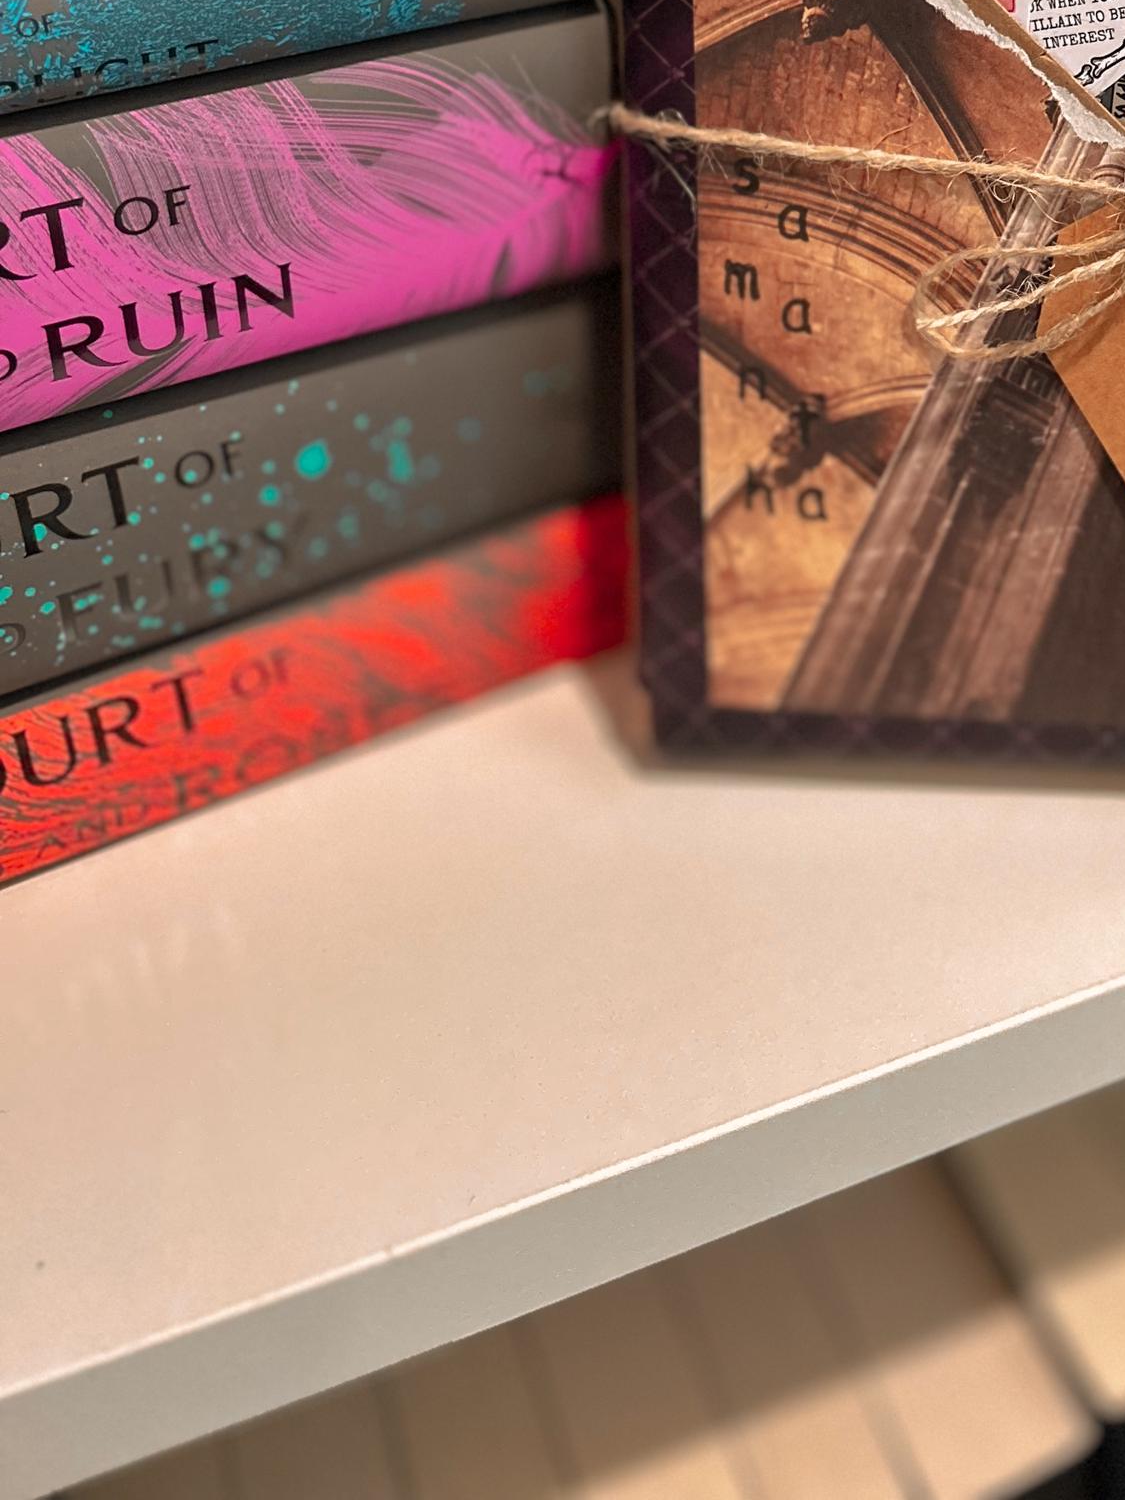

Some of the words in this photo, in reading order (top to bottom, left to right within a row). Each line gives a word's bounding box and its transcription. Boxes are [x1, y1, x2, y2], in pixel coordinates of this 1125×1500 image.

[1031, 15, 1083, 33] ILLAIN
[1086, 10, 1105, 24] TO
[1043, 27, 1116, 49] INTEREST
[113, 184, 192, 236] OF
[42, 262, 296, 382] RUIN
[0, 456, 140, 558] RT
[174, 441, 243, 489] OF
[0, 668, 204, 796] URT
[230, 646, 294, 701] OF
